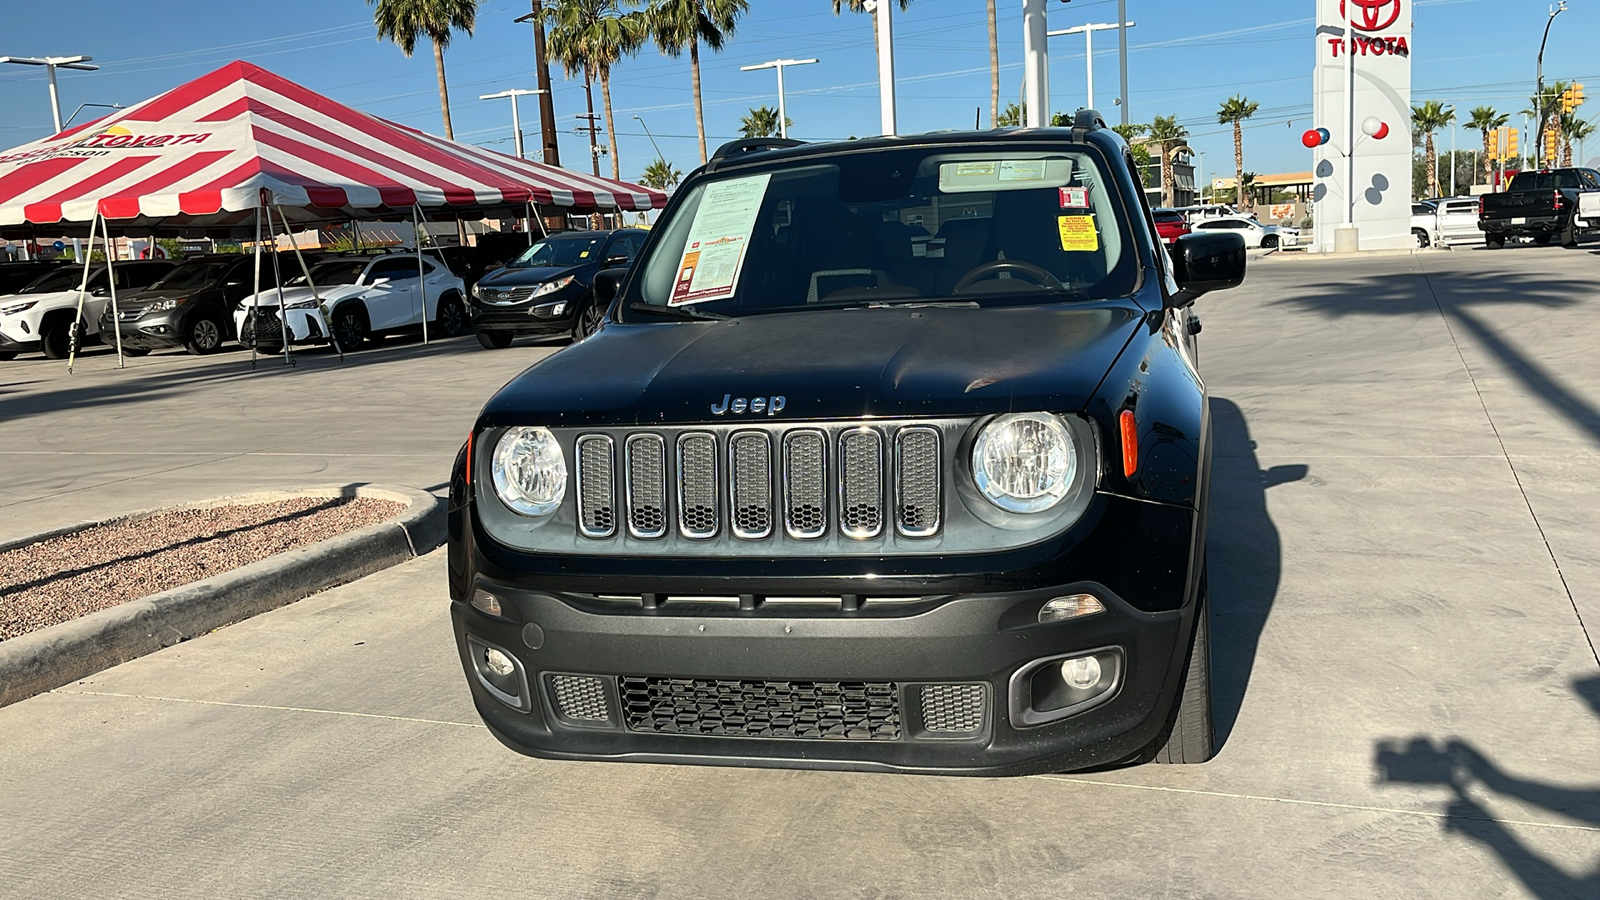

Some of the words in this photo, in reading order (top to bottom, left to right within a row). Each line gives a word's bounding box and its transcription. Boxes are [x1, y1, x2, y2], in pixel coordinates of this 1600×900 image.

[1328, 37, 1409, 57] TOYOTA
[88, 133, 212, 147] TOYOTA
[710, 394, 787, 416] Jeep
